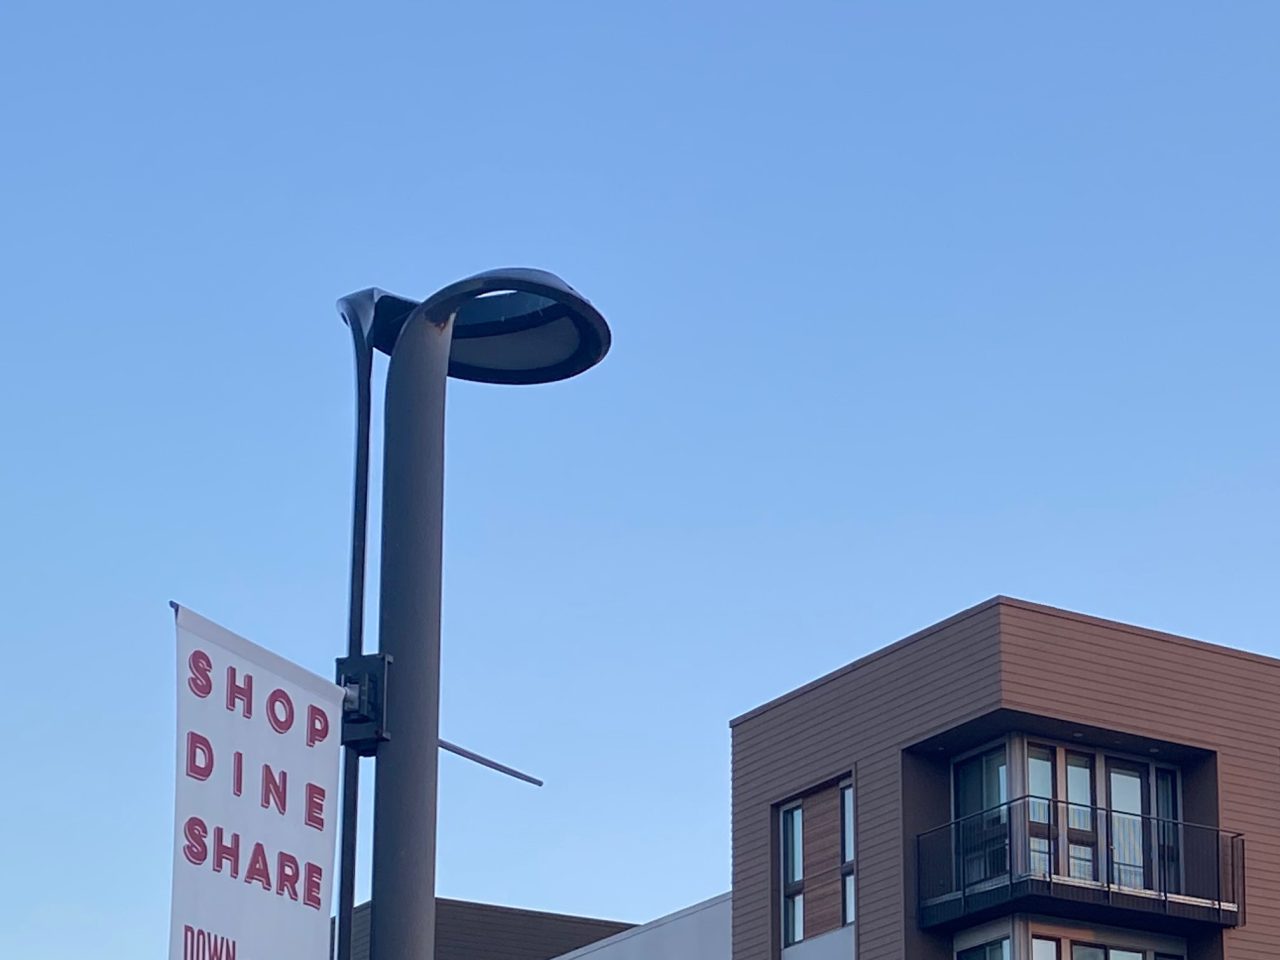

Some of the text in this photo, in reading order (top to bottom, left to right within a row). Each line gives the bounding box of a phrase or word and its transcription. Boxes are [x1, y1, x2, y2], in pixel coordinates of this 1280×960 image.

[188, 649, 330, 748] SHOP
[185, 730, 326, 831] DINE
[183, 816, 323, 910] SHARE
